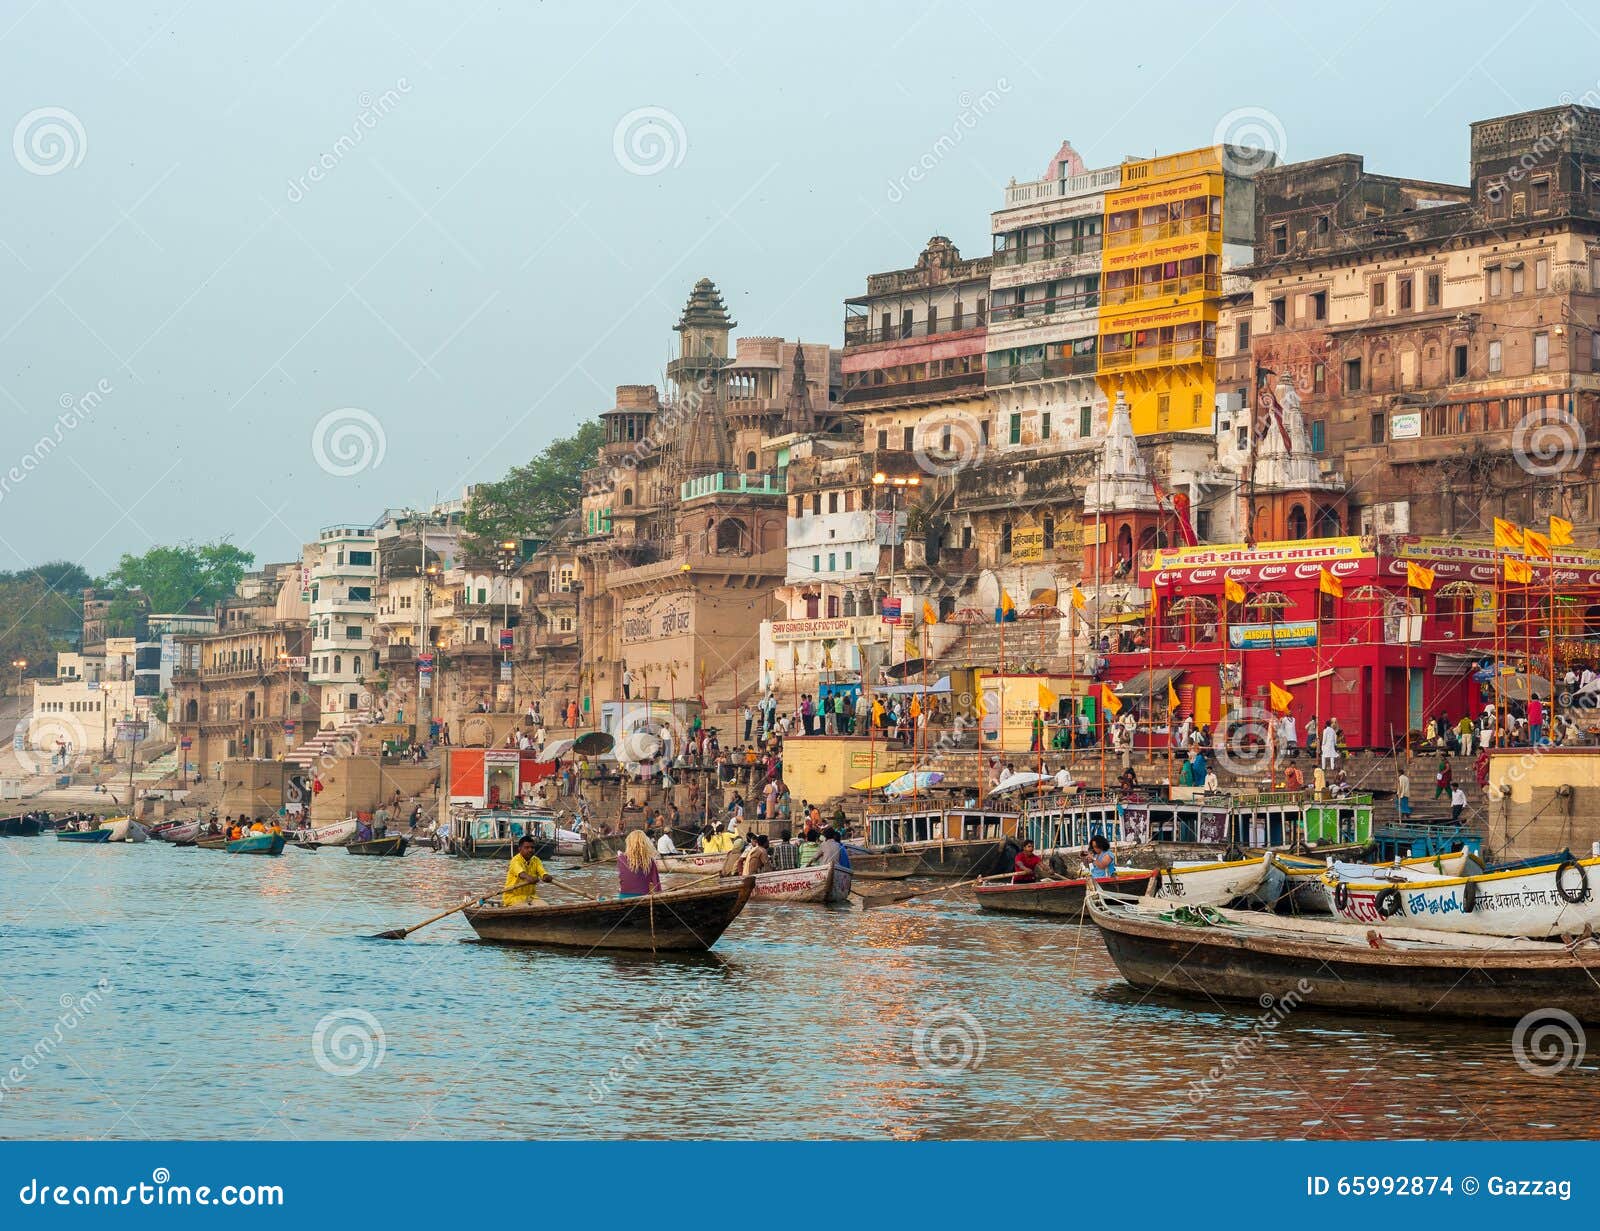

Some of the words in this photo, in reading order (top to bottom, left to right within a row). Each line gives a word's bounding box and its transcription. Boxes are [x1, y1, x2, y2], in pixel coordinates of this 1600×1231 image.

[1184, 552, 1216, 565] बड़ी
[1220, 549, 1283, 562] शीतला
[1288, 546, 1337, 559] माता
[1196, 568, 1217, 577] RUPA
[1231, 566, 1251, 575] RUPA
[1266, 564, 1287, 575] RUPA
[1301, 563, 1323, 574] RUPA
[1337, 561, 1360, 571] RUPA
[1437, 564, 1461, 572] RUPA
[818, 619, 849, 631] FACTORY
[1274, 628, 1291, 638] SEVA
[781, 880, 812, 892] Finance
